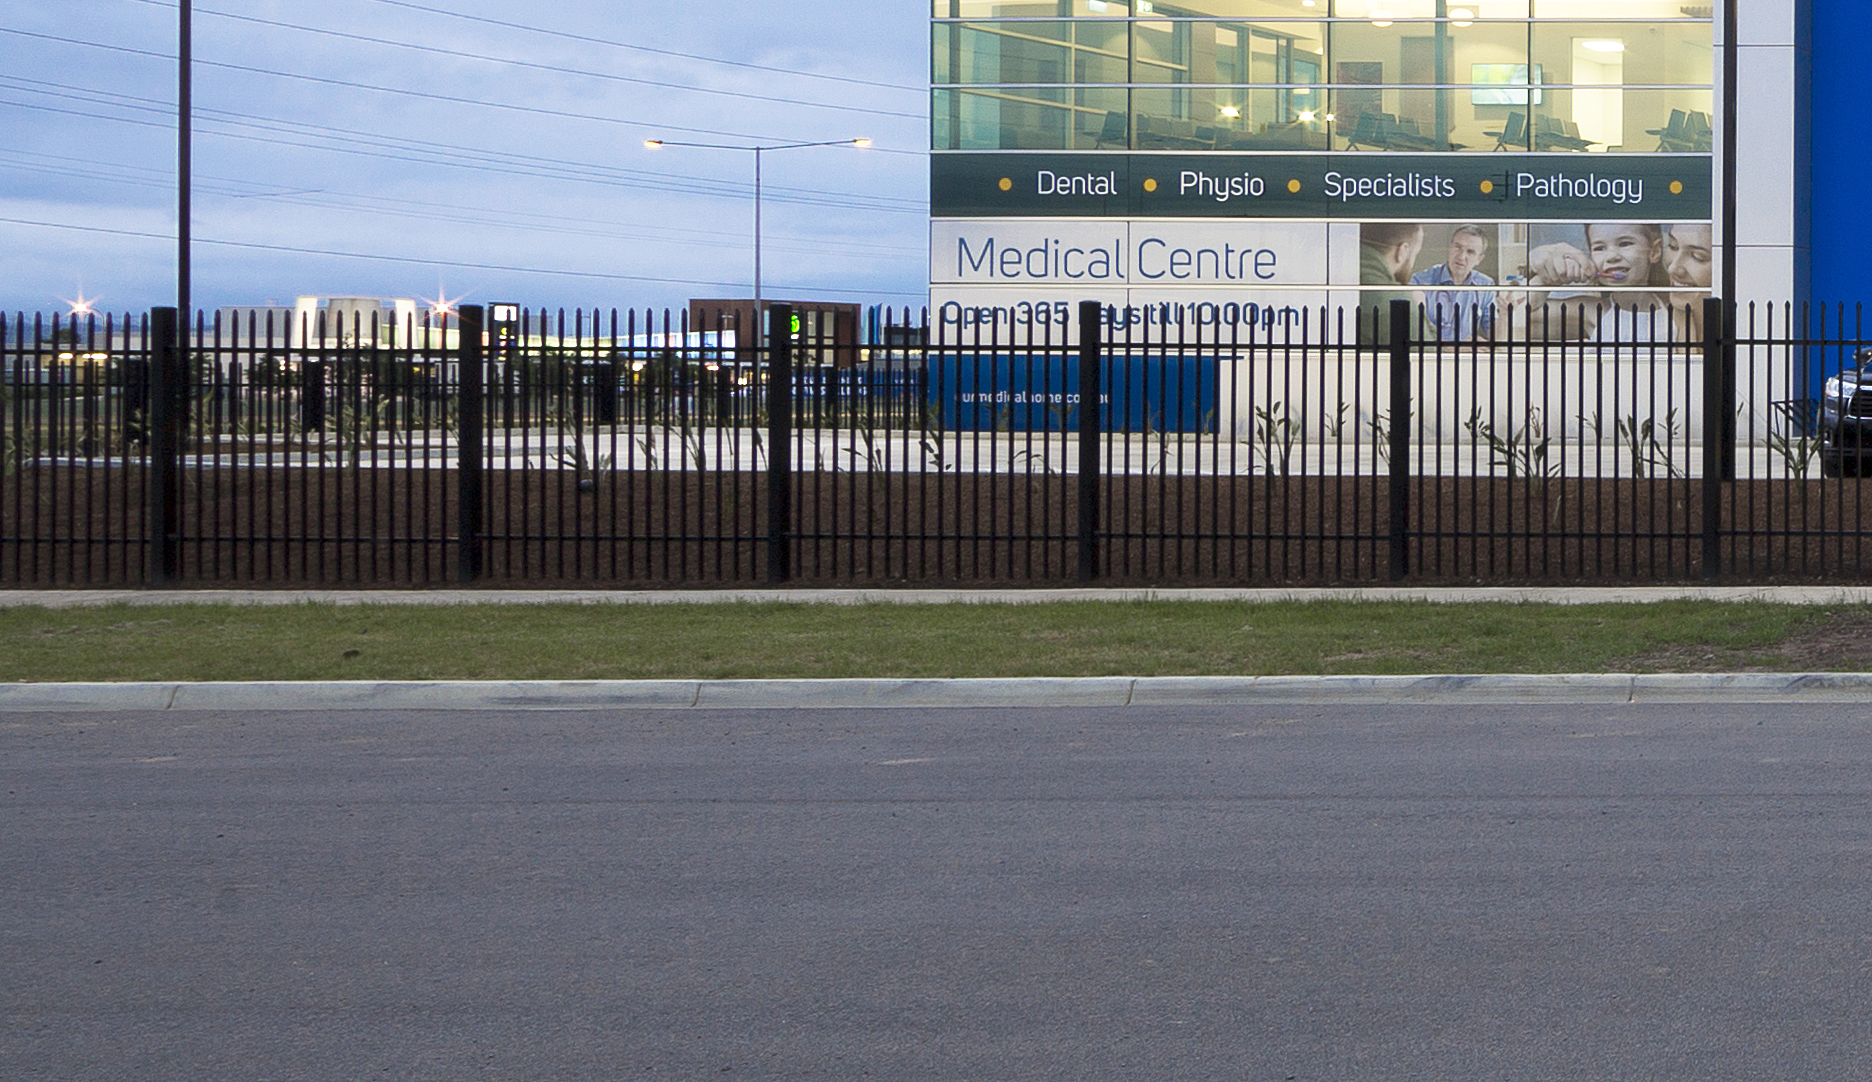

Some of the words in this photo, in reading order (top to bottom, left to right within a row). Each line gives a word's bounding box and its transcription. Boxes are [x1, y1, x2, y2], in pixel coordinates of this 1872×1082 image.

[1038, 170, 1117, 195] Dental
[1180, 171, 1264, 201] Physio
[1324, 172, 1456, 201] Specialists
[1516, 172, 1643, 204] Pathology
[958, 237, 1125, 279] Medical
[1138, 238, 1276, 279] Centre
[943, 301, 1007, 329] Open
[1016, 301, 1069, 325] 365
[1079, 302, 1142, 331] ays
